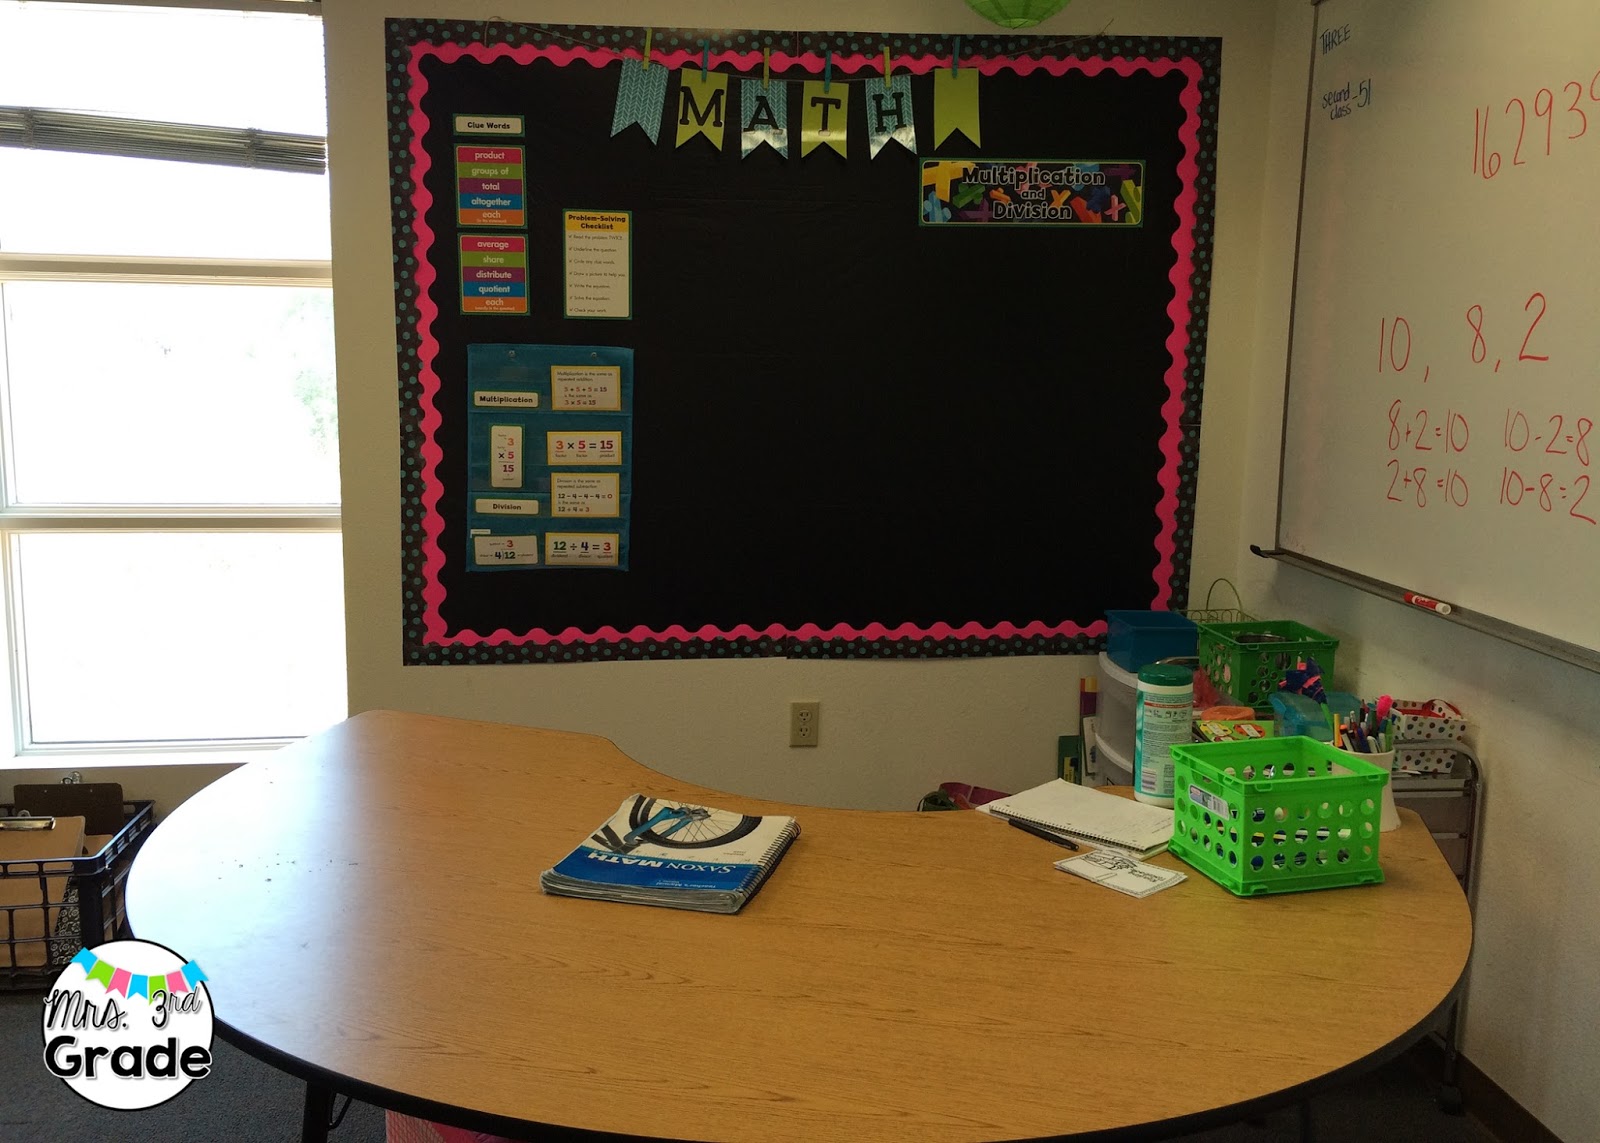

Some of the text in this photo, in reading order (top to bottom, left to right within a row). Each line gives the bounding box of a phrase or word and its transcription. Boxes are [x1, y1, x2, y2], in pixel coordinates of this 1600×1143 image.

[1320, 24, 1350, 56] THREE
[679, 86, 904, 137] MATH
[1330, 103, 1352, 121] class
[474, 151, 505, 160] product
[471, 167, 509, 176] groups of
[962, 166, 1106, 190] Multiplication
[482, 182, 500, 190] total
[1020, 188, 1046, 200] and
[471, 196, 512, 207] altogether
[482, 210, 500, 218] each
[992, 201, 1072, 220] Division
[568, 214, 626, 222] Problem-Solving
[477, 241, 509, 250] average
[483, 255, 504, 264] share
[476, 270, 512, 278] distribute
[478, 285, 510, 294] quotient
[1519, 292, 1549, 360] 2
[480, 396, 533, 404] Multiplication
[508, 438, 514, 446] 3
[556, 440, 564, 450] 3
[578, 440, 586, 450] 5
[600, 440, 613, 449] 15
[553, 541, 566, 550] 12
[581, 542, 589, 551] 4
[604, 542, 611, 550] 3
[588, 851, 736, 874] SAXON MATH
